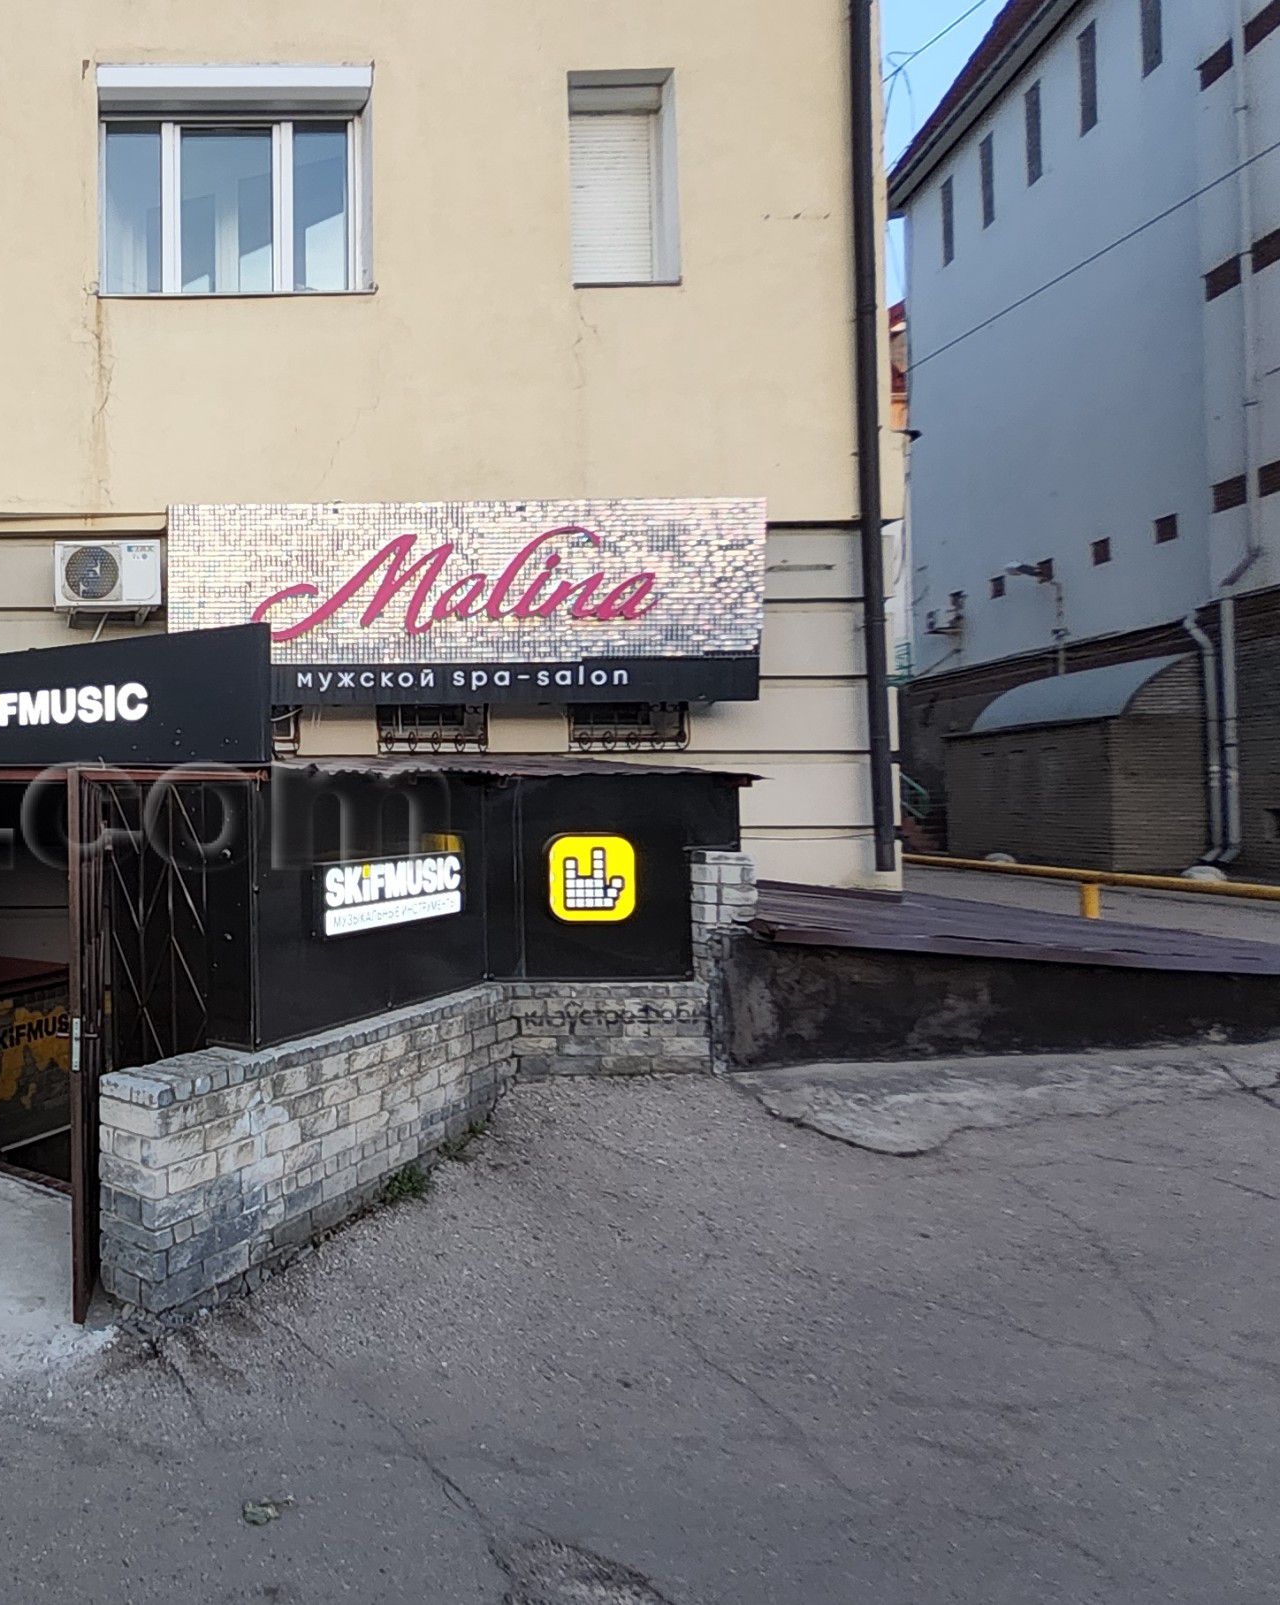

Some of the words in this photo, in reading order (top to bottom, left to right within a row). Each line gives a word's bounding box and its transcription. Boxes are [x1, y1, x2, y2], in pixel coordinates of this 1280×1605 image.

[252, 526, 657, 641] Malina
[297, 666, 435, 694] мужской
[452, 666, 630, 694] spa-salon
